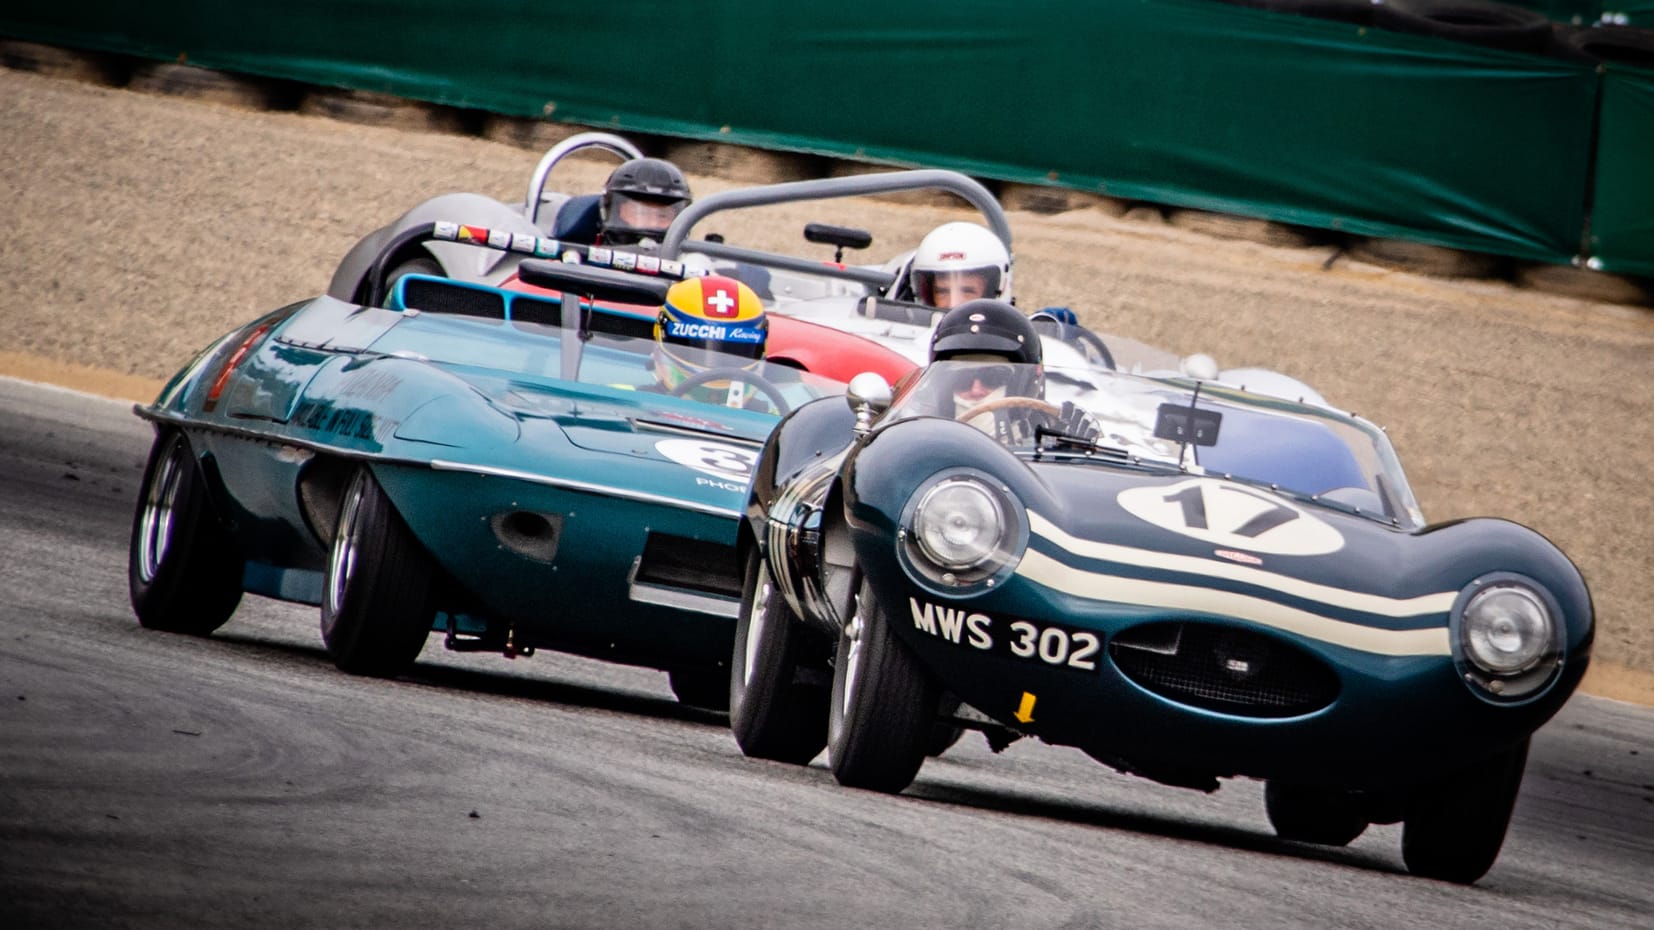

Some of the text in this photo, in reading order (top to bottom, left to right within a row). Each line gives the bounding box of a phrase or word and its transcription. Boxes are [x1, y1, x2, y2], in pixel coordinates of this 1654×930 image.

[671, 322, 762, 343] ZUCCHI Racing
[1163, 484, 1300, 538] 17
[909, 596, 1100, 671] MWS 302
